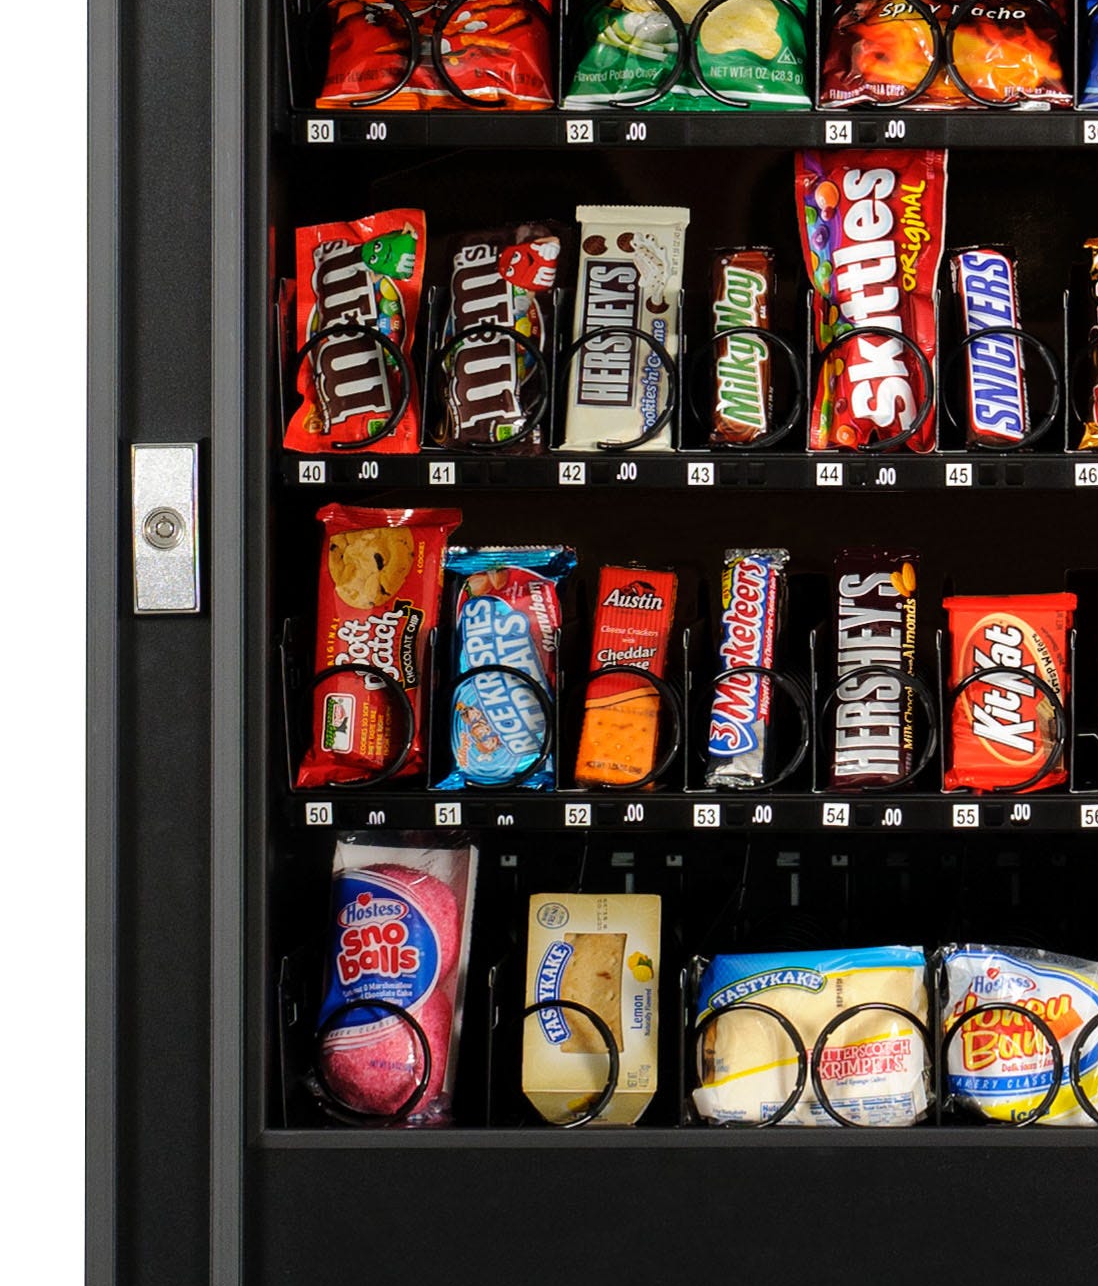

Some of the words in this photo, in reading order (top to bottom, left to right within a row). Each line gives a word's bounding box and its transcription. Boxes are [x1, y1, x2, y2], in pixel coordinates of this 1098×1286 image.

[711, 66, 728, 77] NET
[311, 124, 330, 140] 30
[366, 122, 387, 140] .00
[570, 124, 589, 140] 32
[625, 123, 647, 141] .00
[829, 125, 848, 141] 34
[885, 120, 905, 138] .00
[714, 267, 765, 333] Way
[832, 168, 917, 431] Skittles
[581, 265, 637, 402] HERSHEY'S
[962, 254, 1024, 434] SNICKERS
[717, 332, 767, 427] Milky
[302, 467, 321, 482] 40
[432, 467, 451, 482] 41
[562, 466, 581, 480] 42
[616, 463, 637, 480] .00
[691, 468, 710, 483] 43
[820, 466, 839, 481] 44
[949, 468, 968, 483] 45
[1078, 468, 1097, 483] 46
[602, 589, 664, 610] Austin
[406, 614, 420, 633] CHIP
[902, 598, 917, 661] Almonds
[404, 635, 416, 684] CHOCOLATE
[597, 646, 657, 662] Cheddar
[835, 572, 904, 776] HERSHEY'S
[493, 705, 540, 755] RICE
[710, 723, 741, 749] 3
[310, 807, 328, 822] 50
[438, 806, 457, 822] 51
[569, 808, 587, 824] 52
[697, 809, 716, 824] 53
[752, 805, 772, 823] .00
[826, 807, 845, 822] 54
[881, 808, 902, 826] .00
[956, 809, 975, 823] 55
[1010, 803, 1030, 820] .00
[345, 901, 401, 924] Hostess
[342, 922, 406, 956] sno
[339, 945, 417, 982] balls
[712, 970, 824, 1009] TASTYKAKE
[631, 994, 644, 1030] Lemon
[818, 1055, 905, 1080] KRIMPETS
